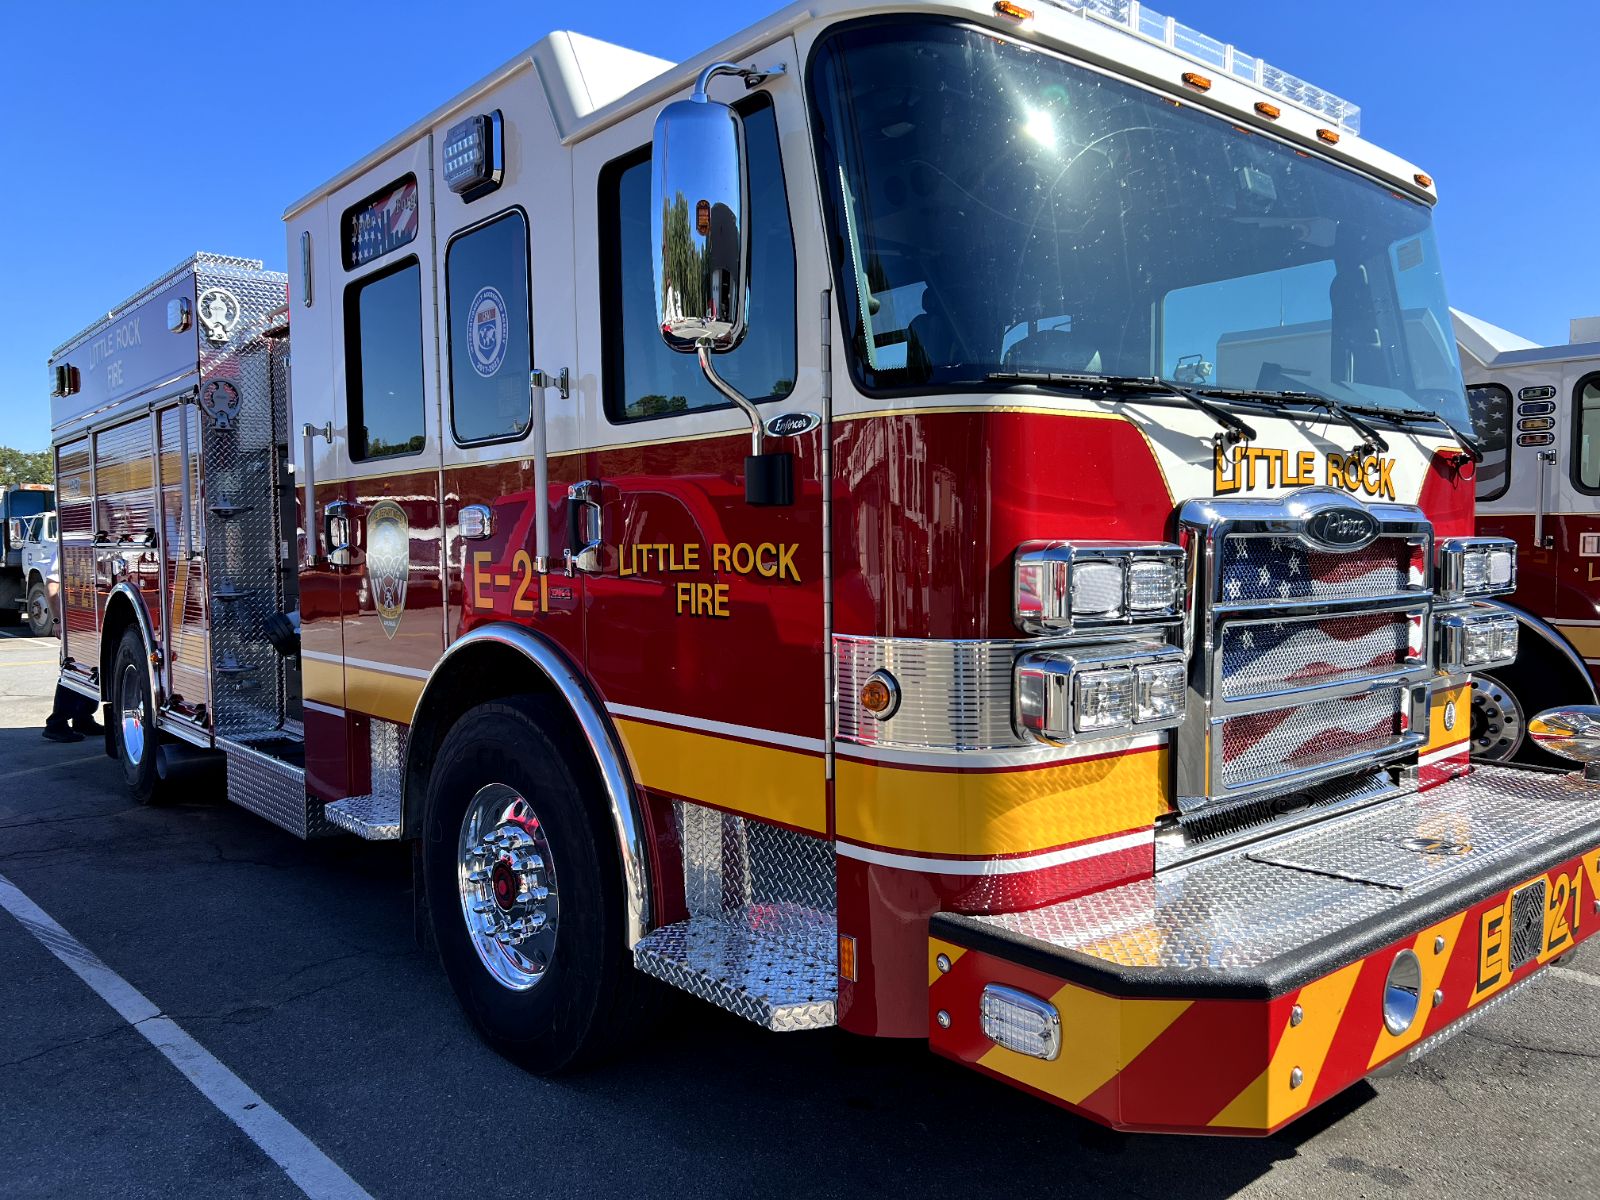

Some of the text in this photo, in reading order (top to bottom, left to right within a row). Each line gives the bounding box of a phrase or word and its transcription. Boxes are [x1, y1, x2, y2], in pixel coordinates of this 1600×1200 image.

[89, 317, 142, 371] LITTLE ROCK
[107, 360, 124, 391] FIRE
[774, 418, 807, 432] Enforcer
[1213, 445, 1396, 501] LITTLE ROCK
[473, 549, 549, 613] E-21
[618, 542, 802, 583] LITTLE ROCK
[676, 582, 731, 617] FIRE
[1476, 865, 1584, 993] E 21
